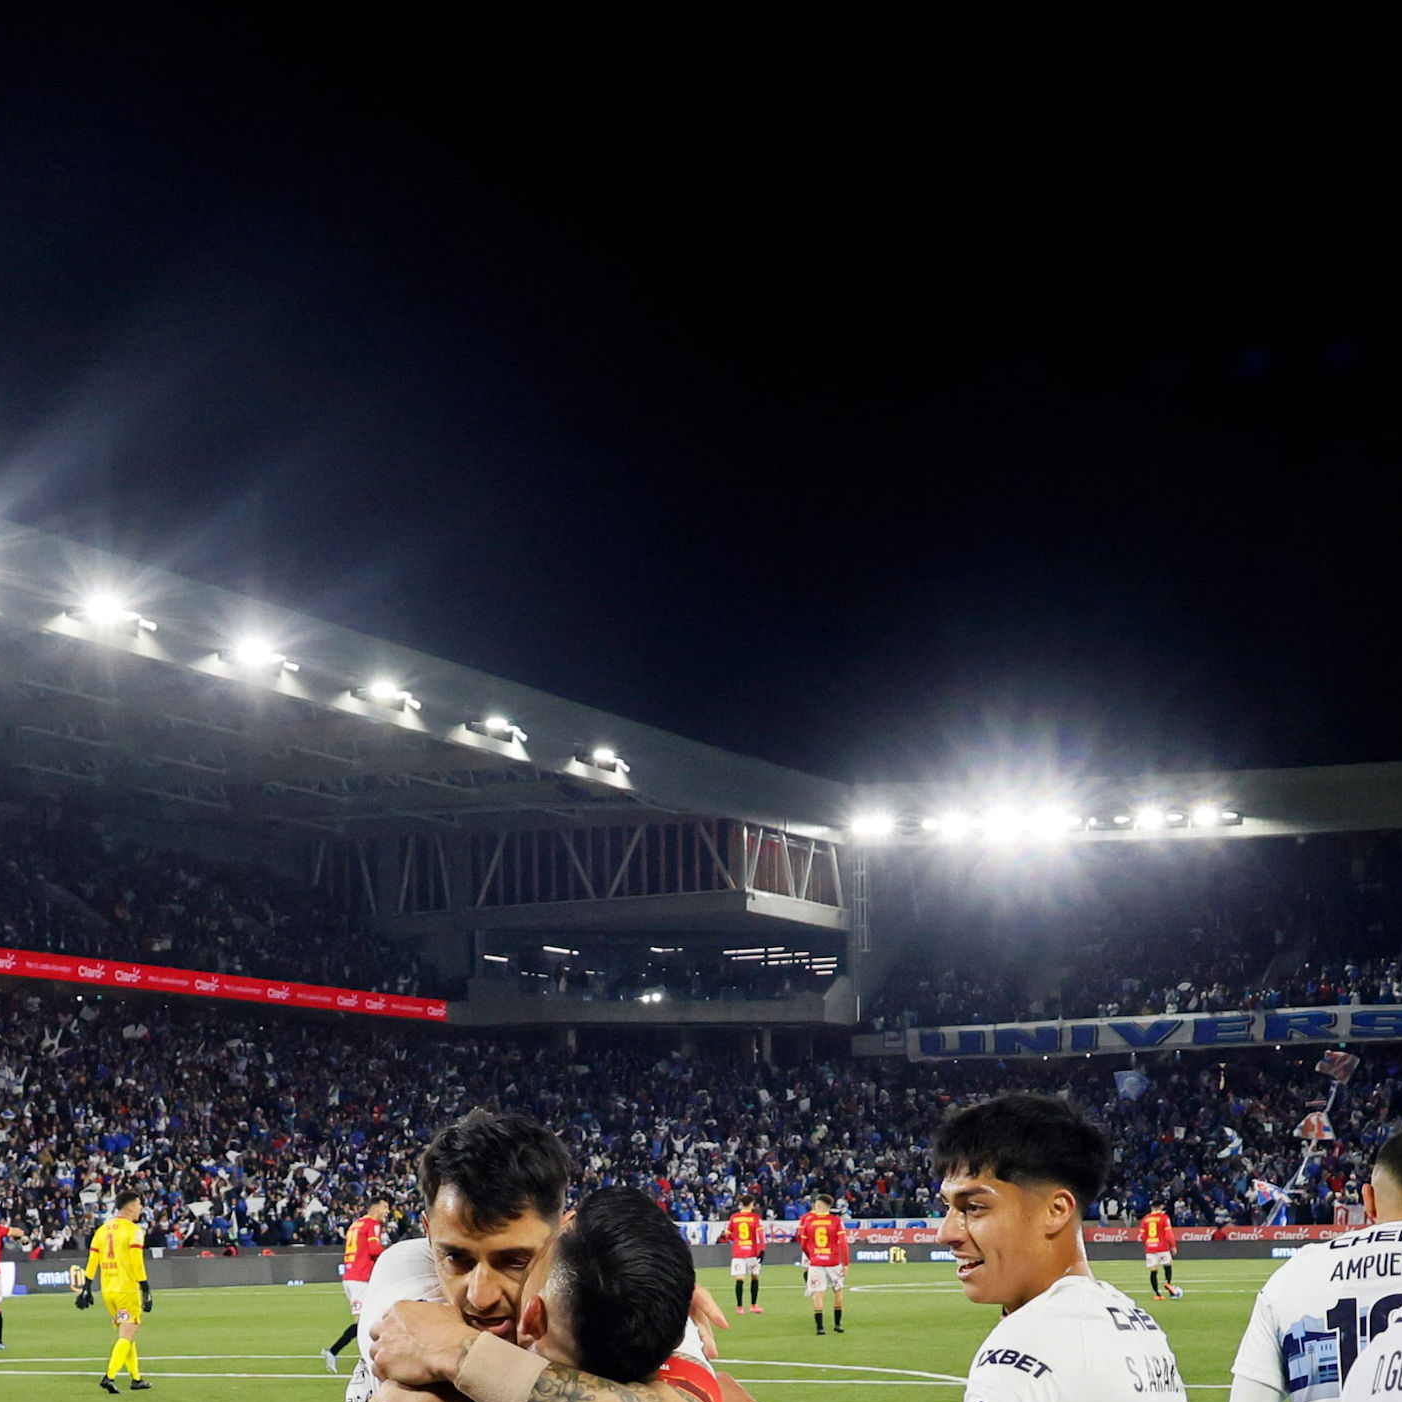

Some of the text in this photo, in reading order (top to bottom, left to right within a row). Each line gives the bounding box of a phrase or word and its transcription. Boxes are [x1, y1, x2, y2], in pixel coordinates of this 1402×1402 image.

[739, 1222, 750, 1240] 9
[814, 1226, 828, 1248] 6
[1093, 1229, 1128, 1241] Claro
[1228, 1227, 1263, 1241] Claro
[1273, 1226, 1309, 1240] Claro
